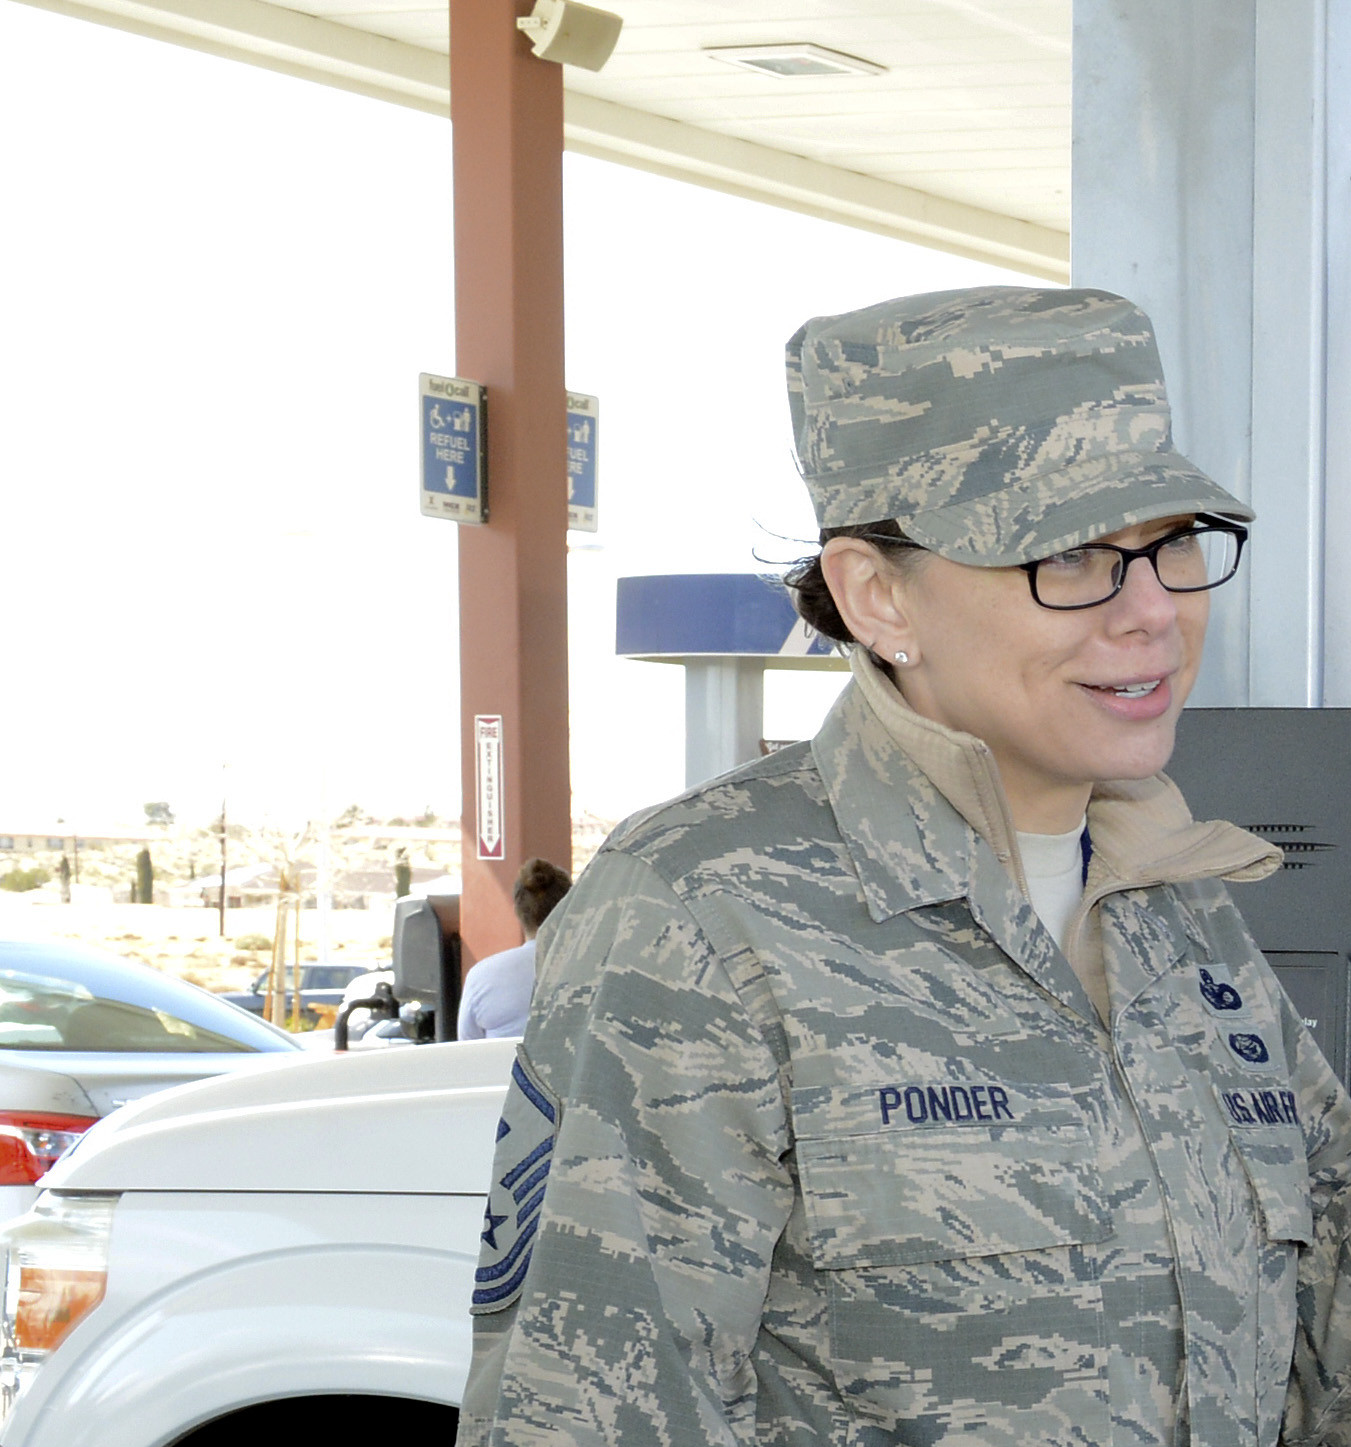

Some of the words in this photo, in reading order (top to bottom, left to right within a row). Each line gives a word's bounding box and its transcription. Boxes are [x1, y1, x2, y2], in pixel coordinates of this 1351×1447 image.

[430, 432, 470, 451] REFUEL
[435, 448, 465, 464] HERE
[879, 1085, 1016, 1125] PONDER
